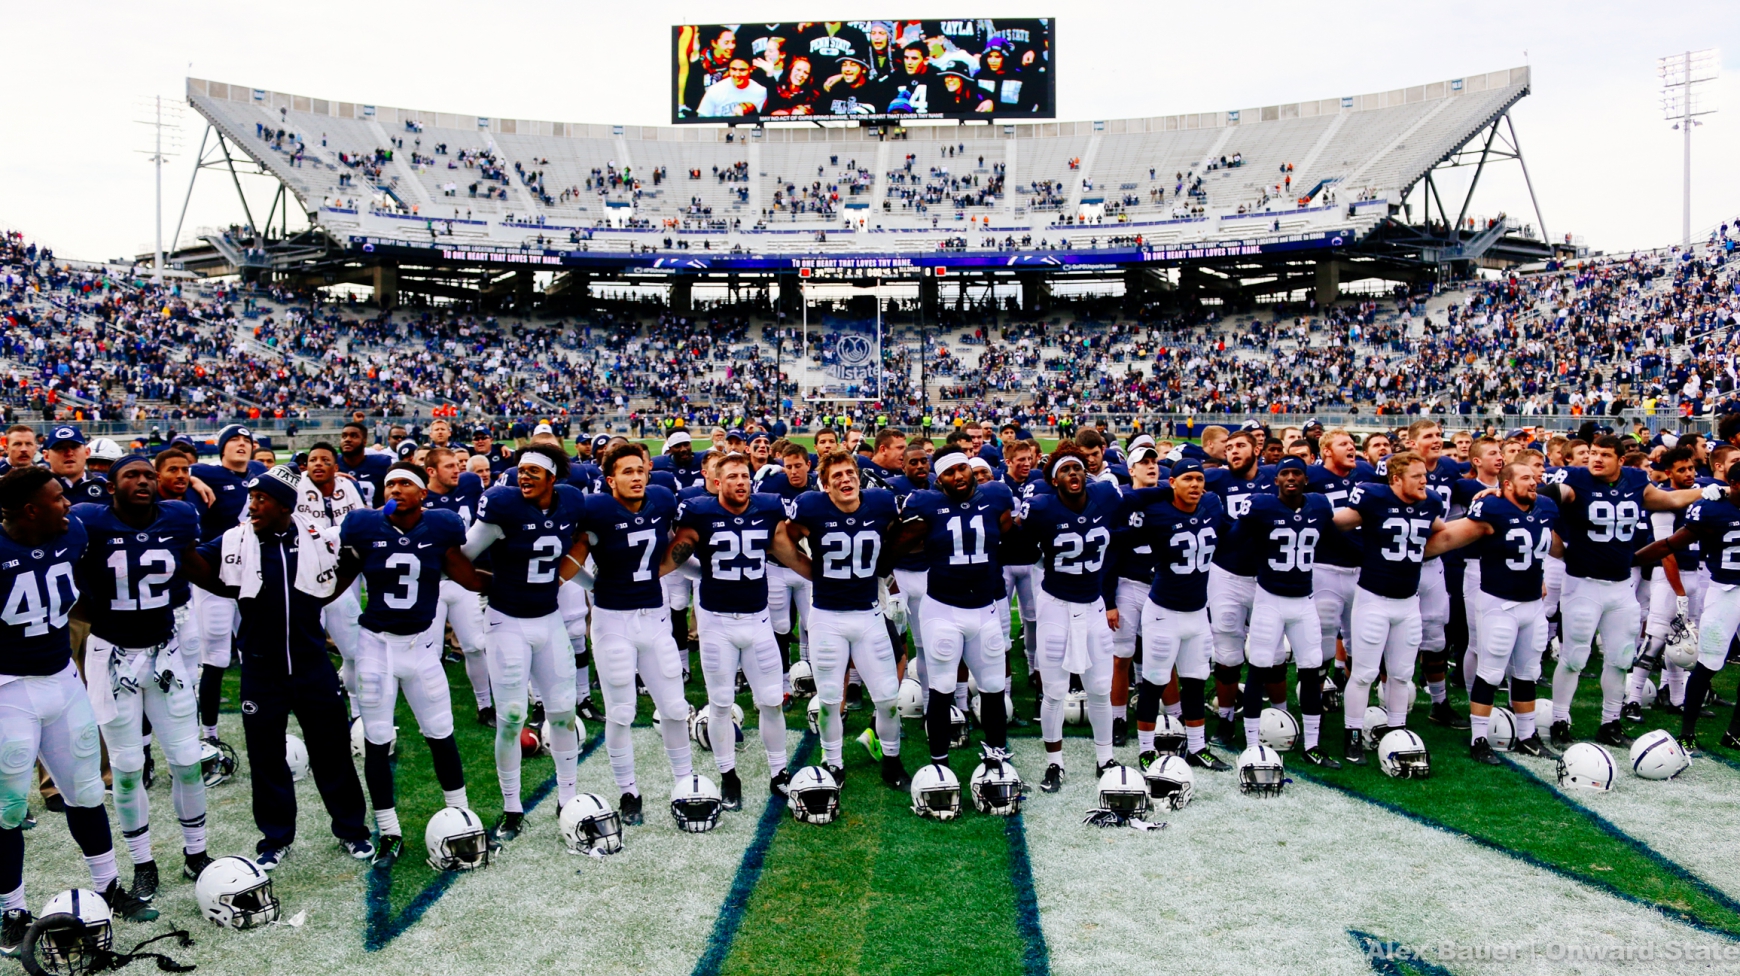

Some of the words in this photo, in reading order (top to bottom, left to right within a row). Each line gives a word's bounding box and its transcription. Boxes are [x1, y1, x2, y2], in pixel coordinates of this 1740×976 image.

[452, 250, 466, 260] ONE
[467, 252, 488, 261] HEART
[490, 253, 506, 262] THAT
[508, 254, 528, 263] LOVES
[528, 255, 542, 264] THY
[543, 256, 562, 265] NAME.
[802, 259, 816, 268] ONE
[816, 259, 837, 268] HEART
[838, 259, 855, 268] THAT
[856, 258, 876, 268] LOVES
[878, 258, 892, 268] THY
[892, 258, 914, 267] NAME.
[1152, 251, 1165, 260] ONE
[1166, 250, 1187, 260] HEART
[1188, 249, 1204, 258] THAT
[1205, 248, 1226, 257] LOVES
[1227, 246, 1241, 256] THY
[1242, 246, 1262, 254] NAME.
[826, 364, 880, 380] Allstate
[271, 468, 300, 488] TATE
[946, 515, 989, 565] 11
[1381, 517, 1432, 563] 35
[1587, 500, 1639, 542] 98
[526, 536, 562, 584] 2
[627, 528, 657, 582] 7
[709, 530, 768, 580] 25
[821, 530, 882, 579] 20
[1054, 526, 1110, 575] 23
[1170, 526, 1217, 574] 36
[1268, 527, 1320, 572] 38
[1505, 527, 1552, 571] 34
[0, 561, 80, 638] 40
[108, 549, 176, 611] 12
[384, 552, 421, 610] 3
